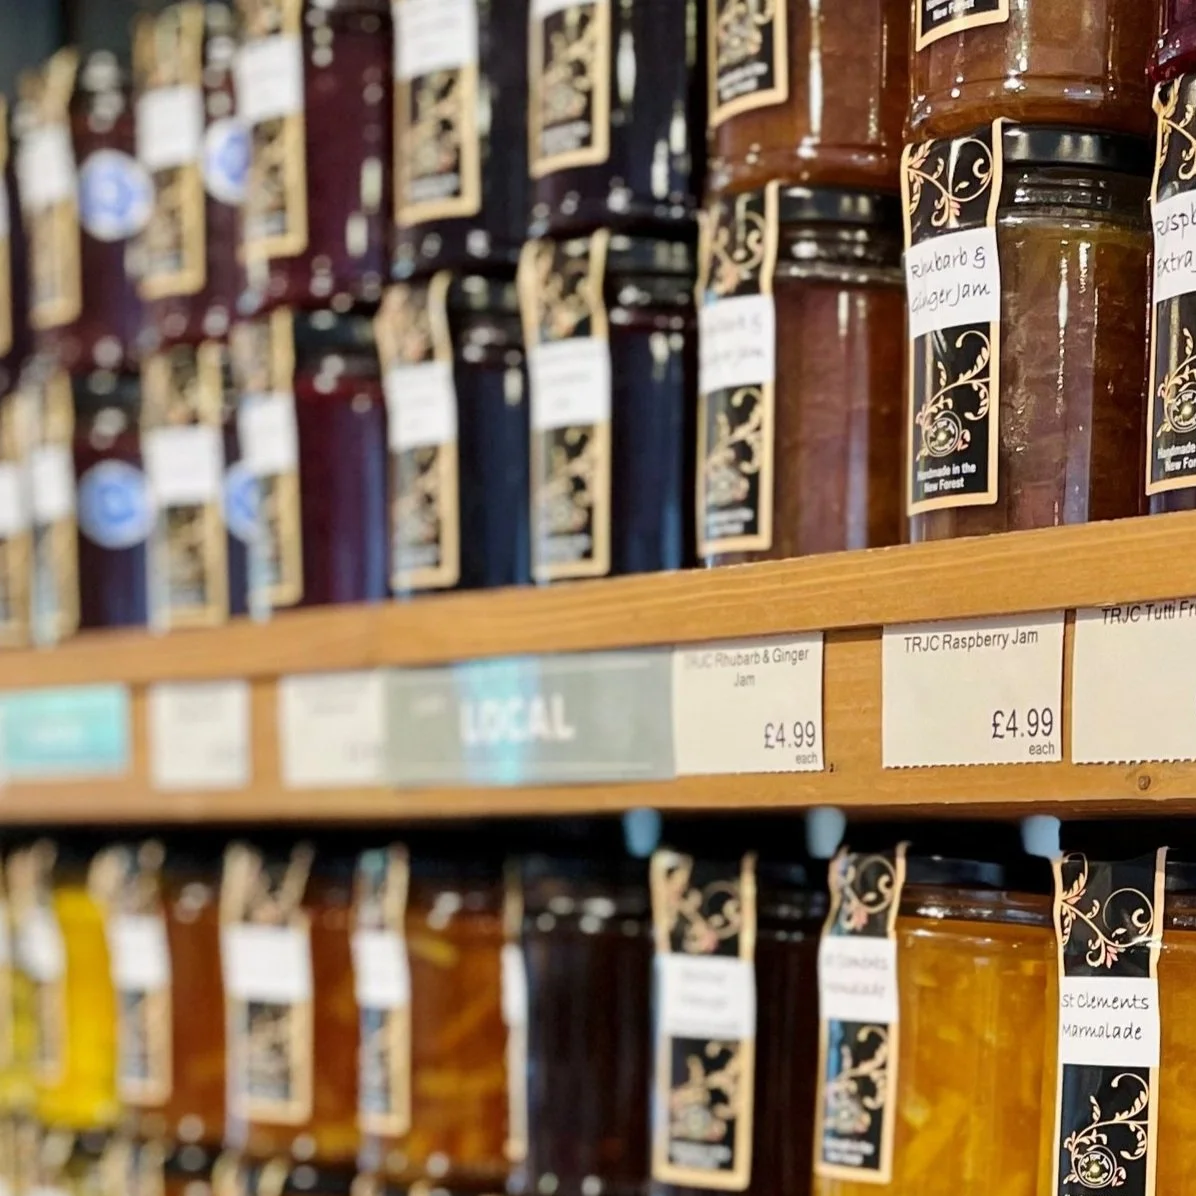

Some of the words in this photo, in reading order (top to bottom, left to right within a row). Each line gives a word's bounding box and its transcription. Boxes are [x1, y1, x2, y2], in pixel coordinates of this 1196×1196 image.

[1101, 605, 1141, 625] TRJC
[1144, 601, 1175, 622] Tutti
[904, 634, 941, 653] TRJC
[942, 630, 1010, 652] Raspberry
[1012, 628, 1039, 645] Jam
[762, 650, 771, 664] &
[772, 648, 810, 666] Ginger
[733, 672, 756, 687] Jam
[992, 707, 1054, 739] £4.99
[764, 720, 817, 749] £4.99
[795, 752, 818, 765] each
[1028, 742, 1055, 756] each
